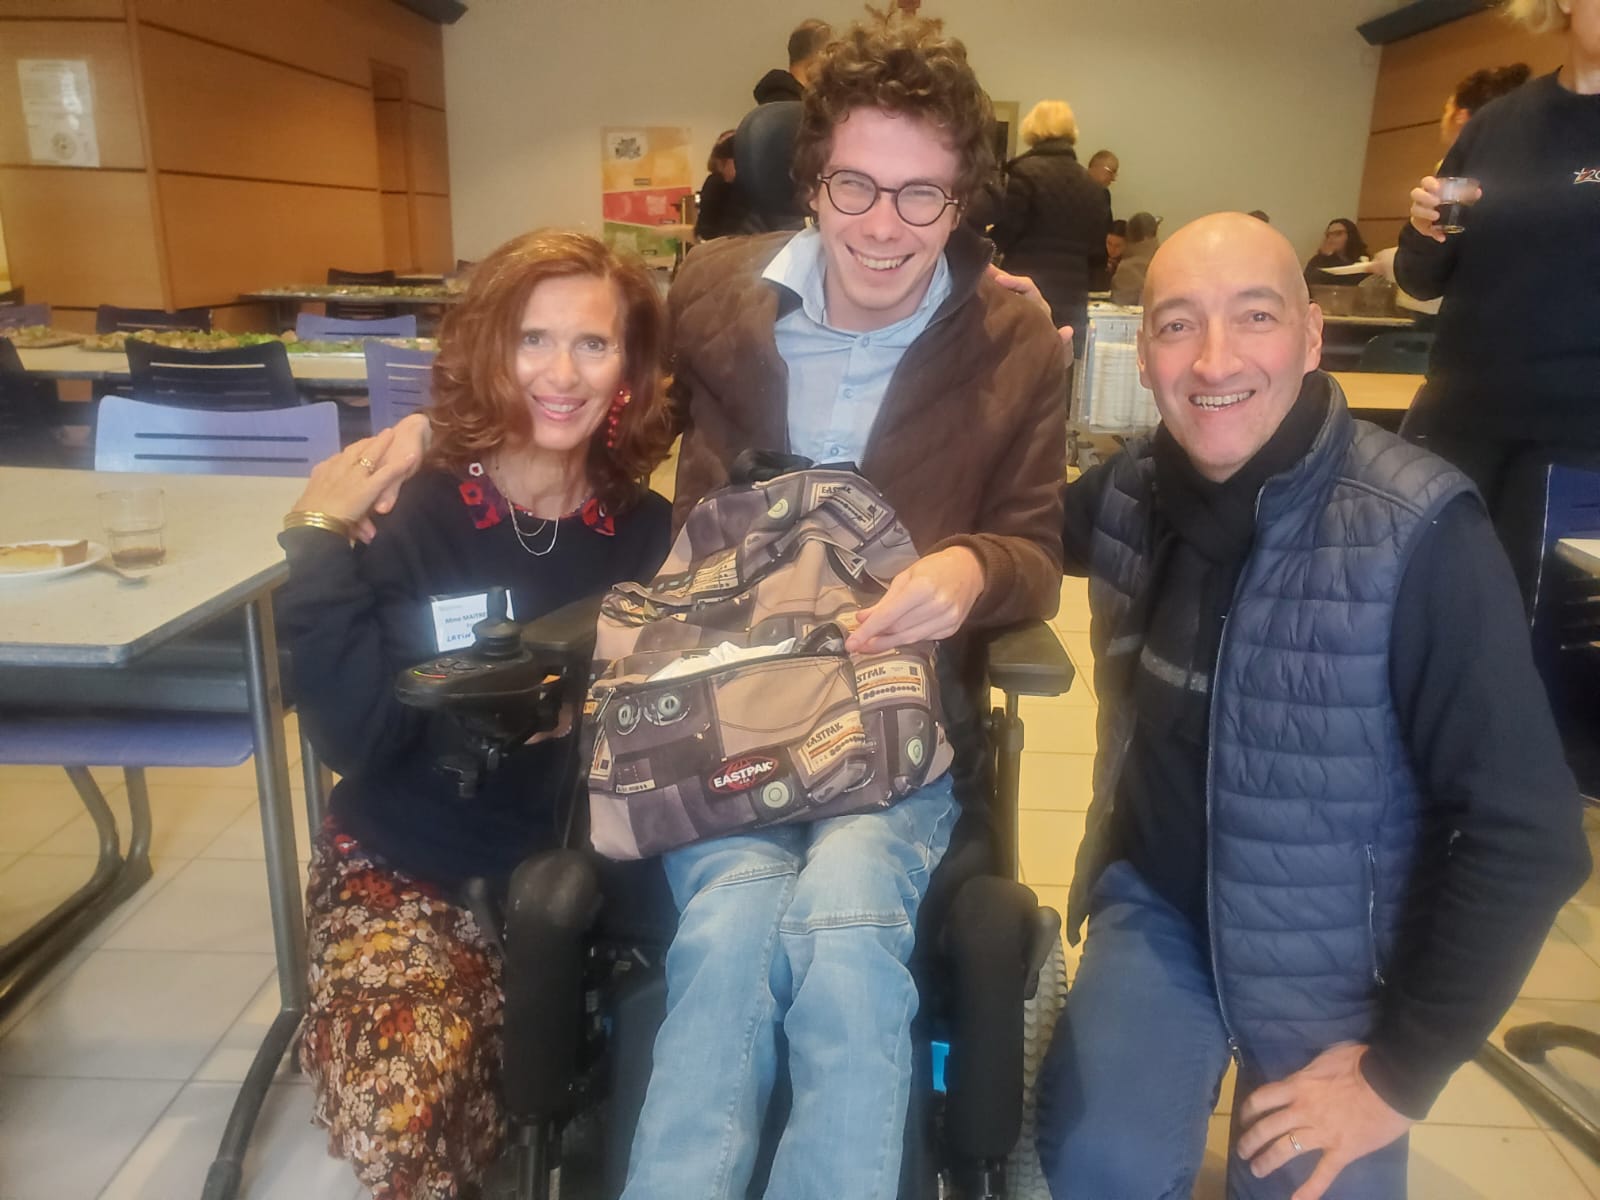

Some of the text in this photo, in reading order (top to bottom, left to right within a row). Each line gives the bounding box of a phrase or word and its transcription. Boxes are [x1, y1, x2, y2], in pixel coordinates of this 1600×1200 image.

[856, 667, 886, 683] STPAK
[806, 722, 844, 748] EASTPAK
[713, 761, 774, 788] EASTPAK
